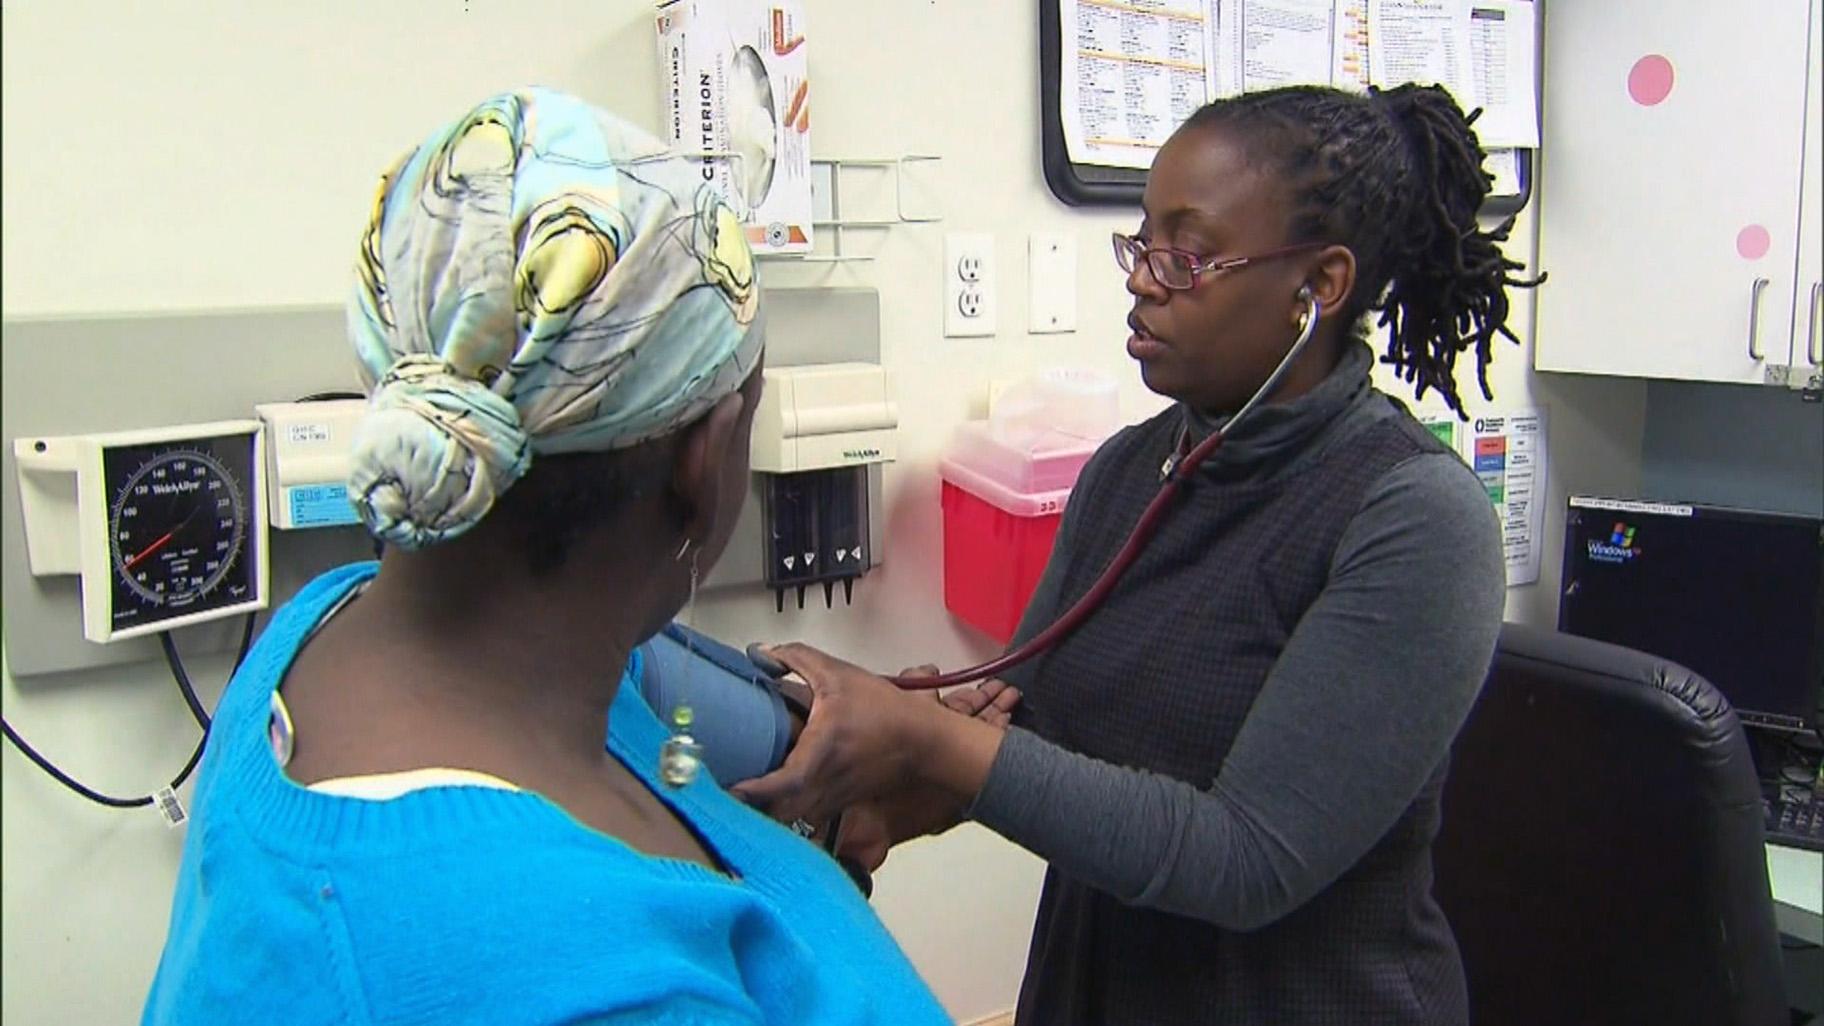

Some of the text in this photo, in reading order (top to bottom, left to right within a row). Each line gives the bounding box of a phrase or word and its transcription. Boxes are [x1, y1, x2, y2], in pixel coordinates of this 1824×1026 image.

[700, 73, 714, 181] CRITERION
[152, 469, 166, 479] 140
[135, 485, 148, 495] 120
[208, 480, 221, 490] 200
[123, 506, 138, 517] 100
[221, 518, 233, 528] 240
[119, 531, 130, 540] 80
[1587, 539, 1632, 558] Windows
[137, 571, 147, 581] 40
